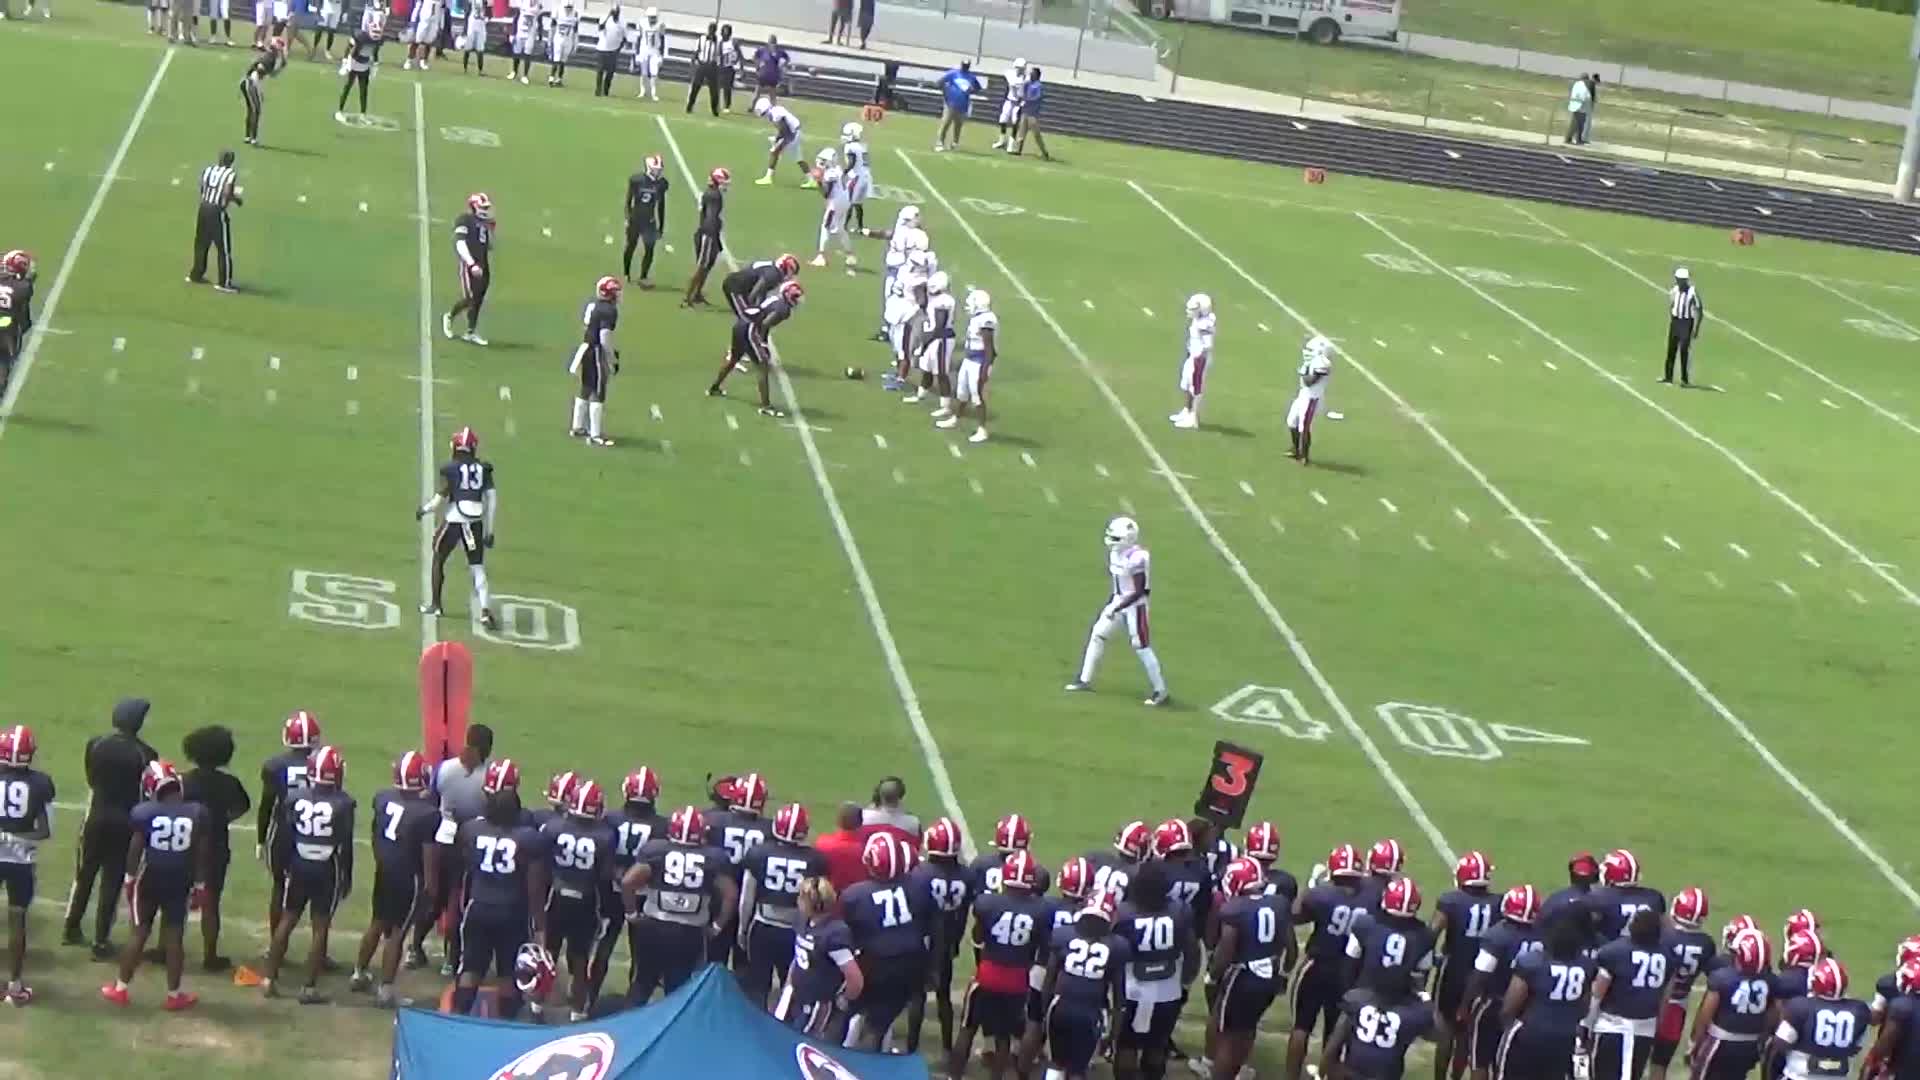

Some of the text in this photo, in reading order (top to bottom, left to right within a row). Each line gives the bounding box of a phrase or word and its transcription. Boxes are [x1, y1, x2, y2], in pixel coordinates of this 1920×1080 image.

[457, 462, 483, 490] 13
[1210, 751, 1255, 797] 3
[150, 815, 193, 852] 28
[294, 799, 332, 837] 32
[384, 801, 404, 841] 7
[476, 835, 517, 873] 73
[554, 833, 595, 870] 39
[616, 821, 651, 857] 17
[663, 850, 704, 888] 95
[764, 856, 807, 893] 55
[872, 886, 912, 928] 71
[1257, 906, 1276, 944] 0
[1464, 903, 1492, 937] 11
[990, 911, 1033, 946] 48
[1134, 915, 1174, 952] 70
[1063, 938, 1107, 980] 22
[1380, 933, 1407, 969] 9
[1631, 950, 1667, 989] 79
[1550, 964, 1585, 1001] 78
[1731, 979, 1769, 1015] 43
[1356, 1005, 1399, 1049] 93
[1815, 1008, 1856, 1048] 60
